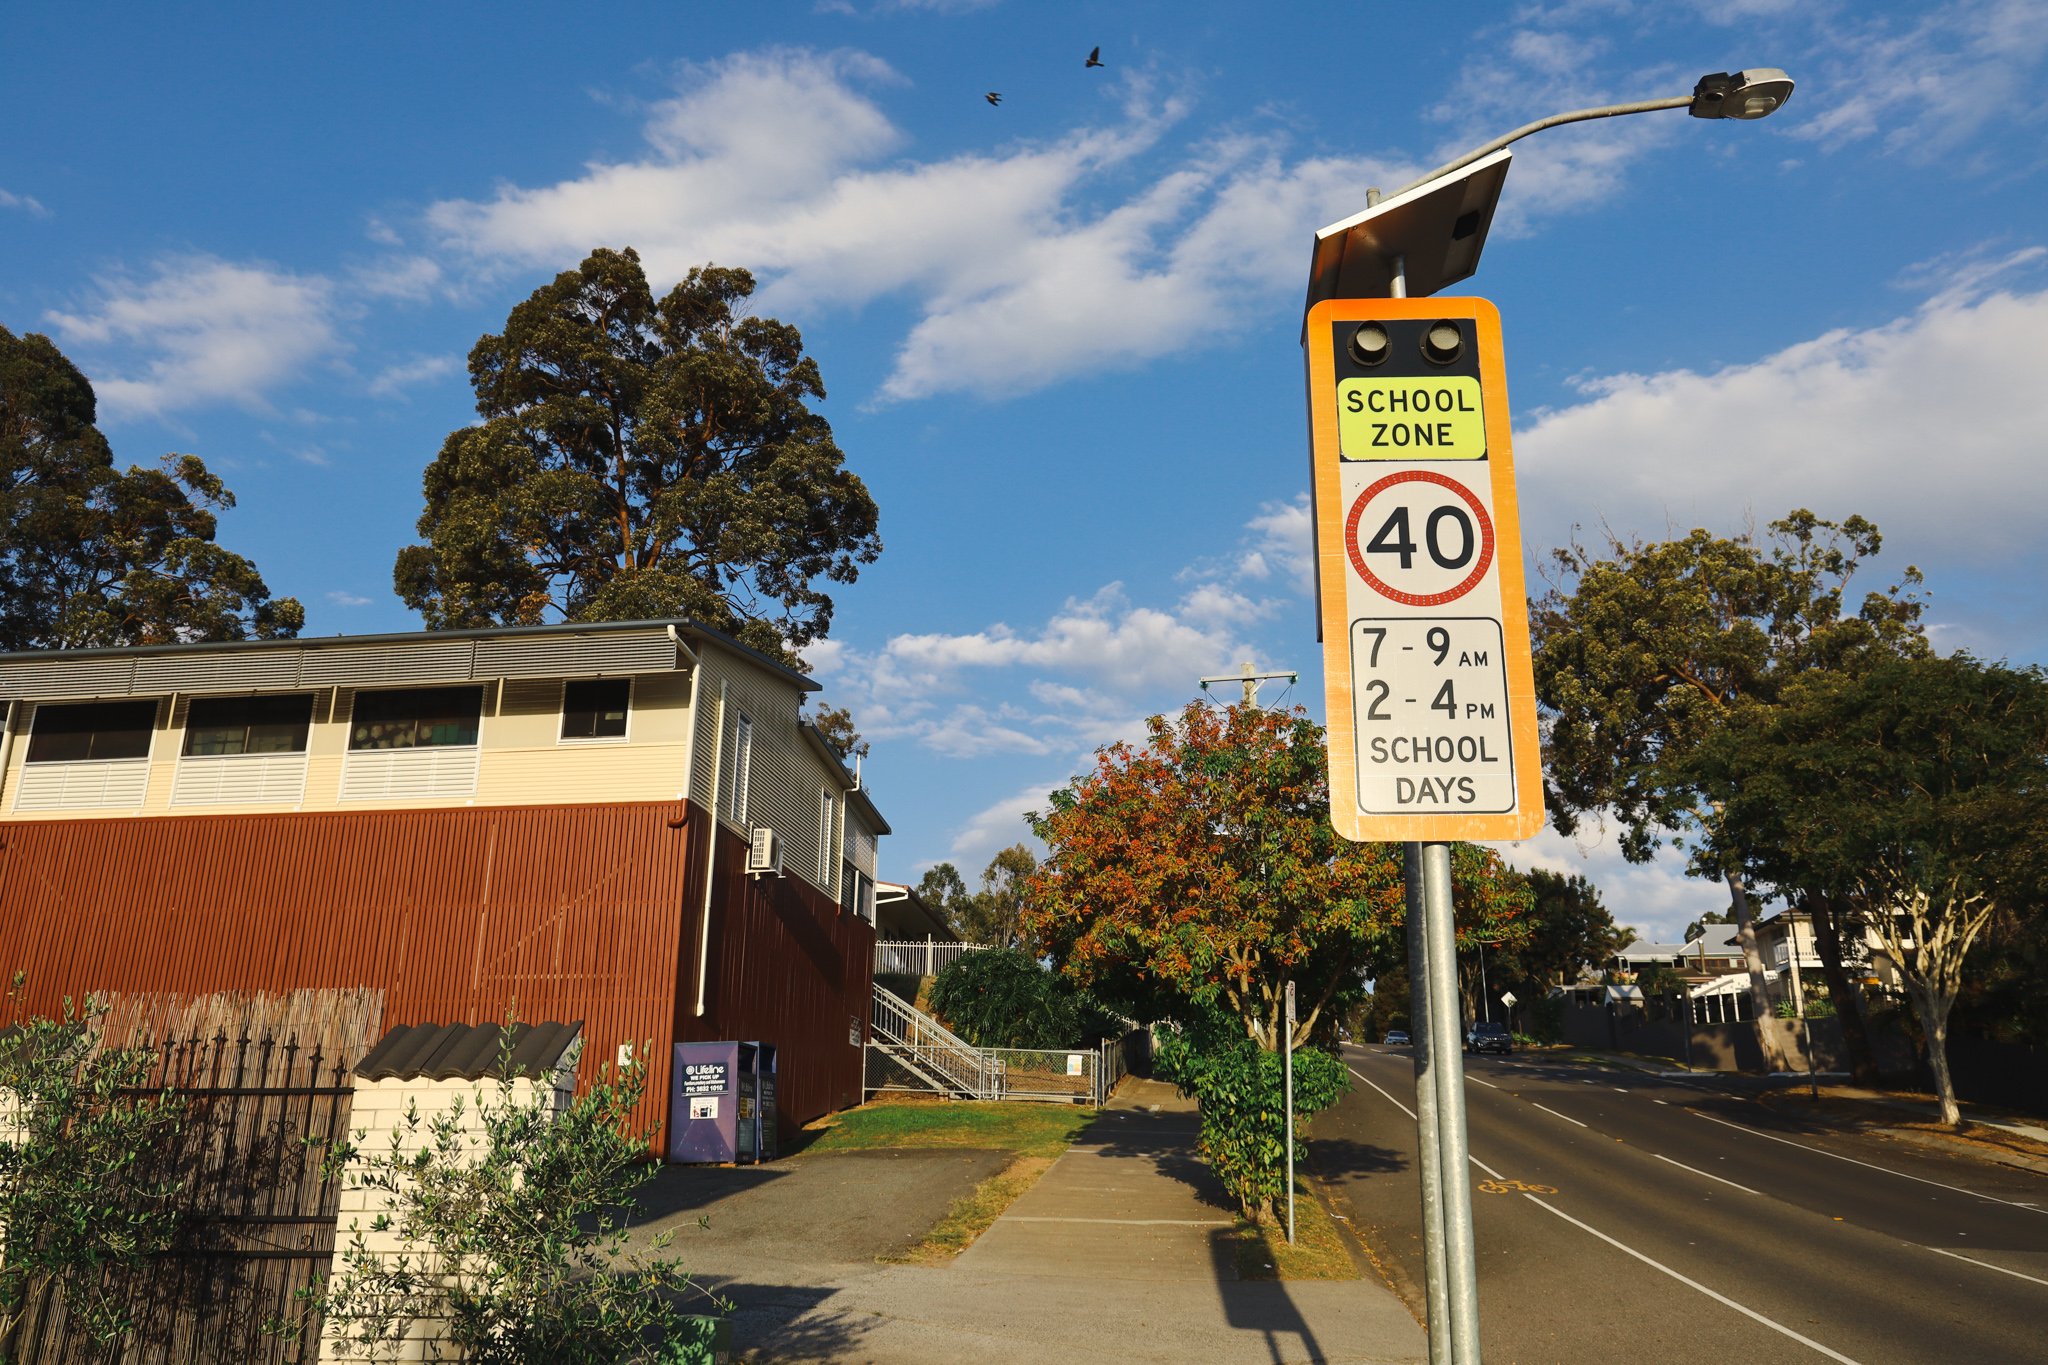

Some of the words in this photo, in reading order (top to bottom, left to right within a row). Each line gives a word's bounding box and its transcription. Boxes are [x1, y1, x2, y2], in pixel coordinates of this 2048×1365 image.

[1347, 389, 1475, 413] SCHOOL
[1371, 423, 1455, 447] ZONE
[1366, 505, 1474, 570] 40
[1458, 651, 1489, 668] AM
[1466, 703, 1496, 720] PM
[1370, 735, 1498, 764] SCHOOL
[1396, 777, 1477, 804] DAYS
[695, 1065, 724, 1074] Lifeline
